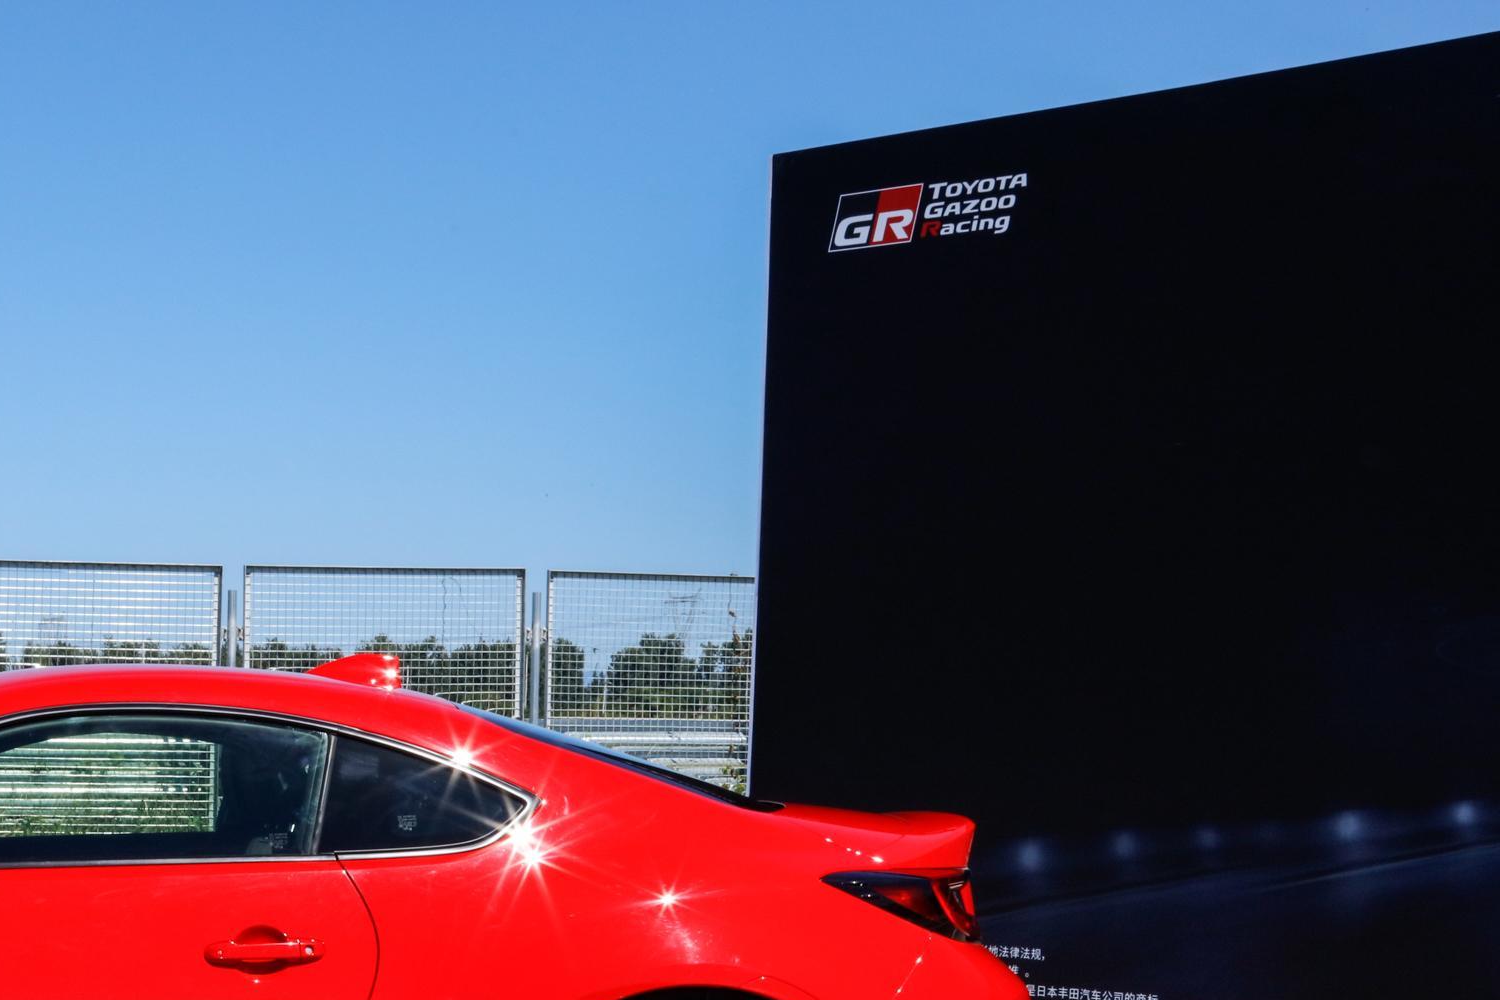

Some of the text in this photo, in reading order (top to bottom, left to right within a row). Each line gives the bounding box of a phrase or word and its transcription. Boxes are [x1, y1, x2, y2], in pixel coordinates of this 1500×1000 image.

[928, 172, 1028, 200] TOYOTA
[923, 194, 1017, 219] GAZOO
[833, 208, 915, 247] GR
[919, 215, 1011, 238] Racing
